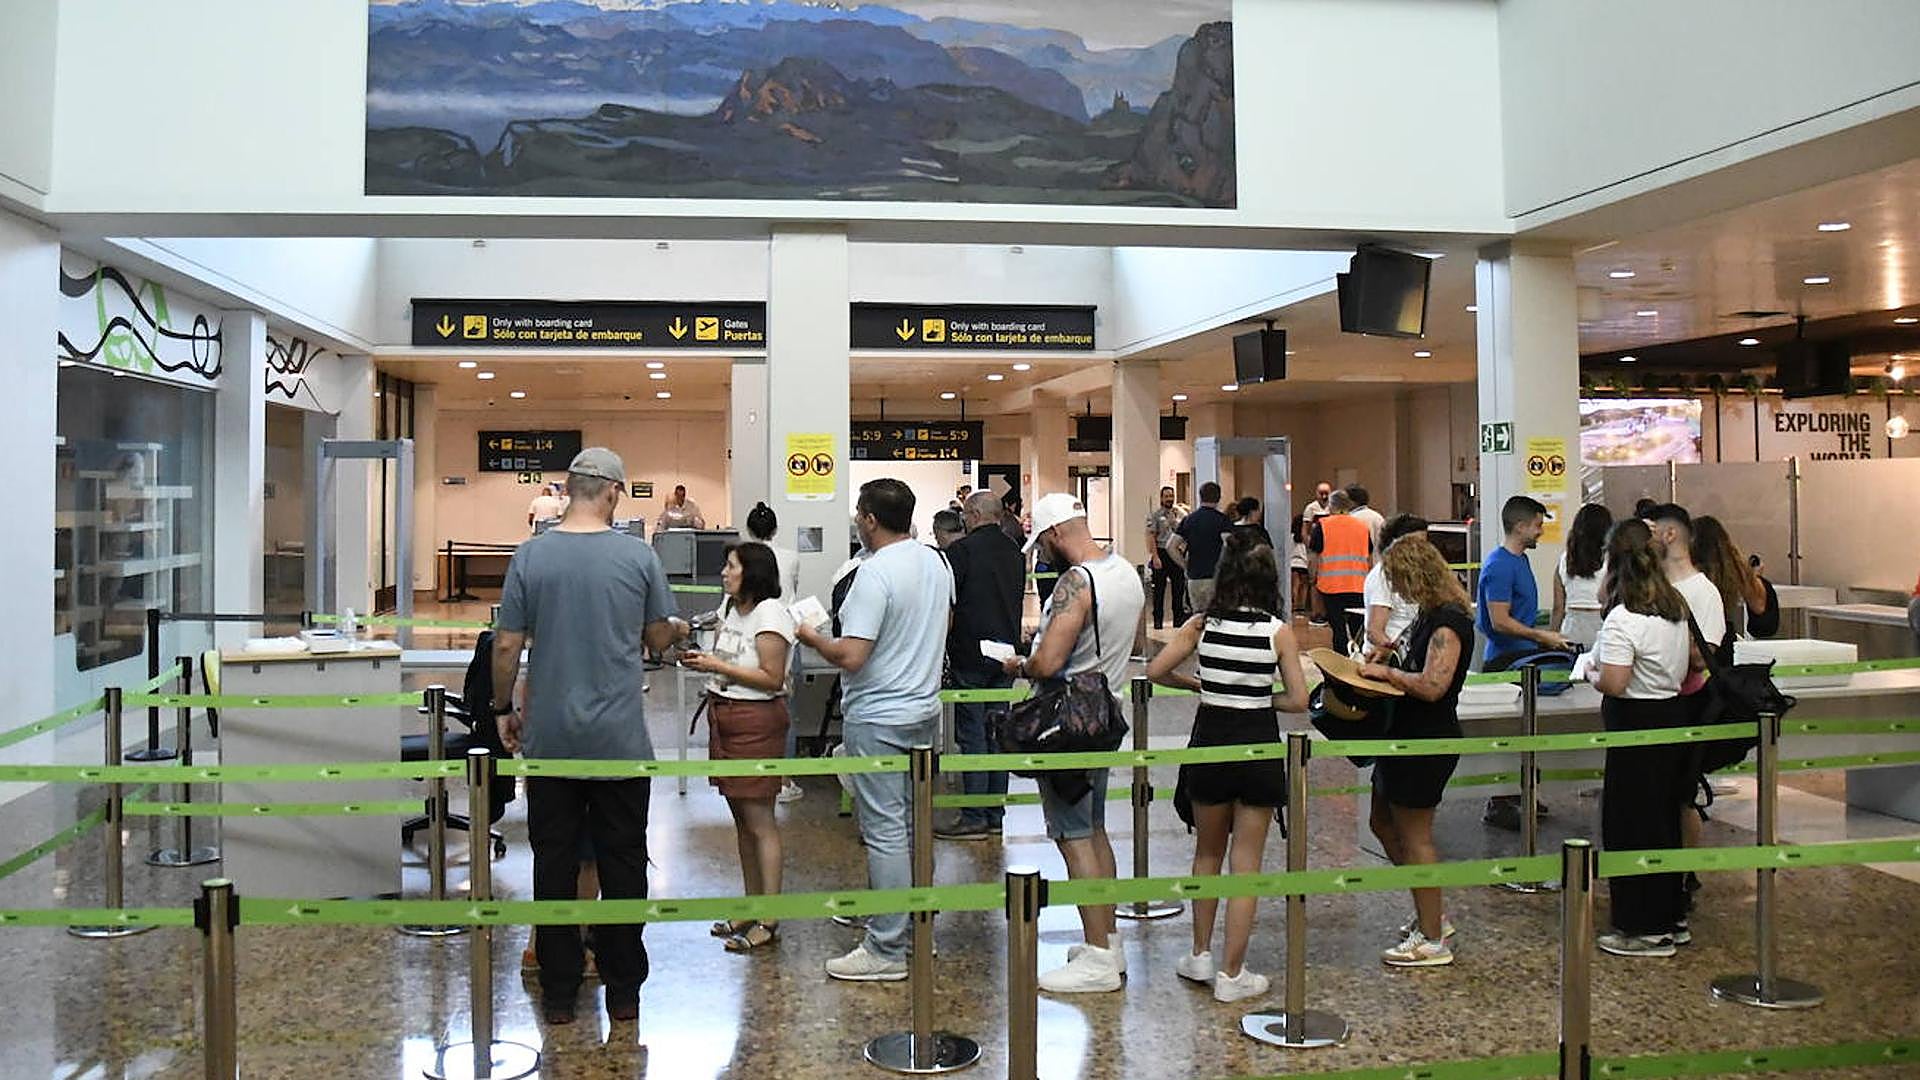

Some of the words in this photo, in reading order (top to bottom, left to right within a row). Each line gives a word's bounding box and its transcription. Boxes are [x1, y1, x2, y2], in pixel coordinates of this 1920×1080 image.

[493, 318, 512, 329] Only
[514, 318, 533, 327] with
[535, 318, 572, 329] boarding
[574, 318, 593, 328] card
[724, 320, 749, 329] Gates
[950, 321, 970, 332] Only
[971, 322, 989, 331] with
[991, 321, 1026, 333] boarding
[1027, 323, 1046, 331] card
[493, 328, 516, 339] Sólo
[518, 330, 538, 339] con
[540, 329, 573, 341] tarjeta
[575, 329, 589, 340] de
[591, 329, 643, 342] embarque
[724, 330, 763, 341] Puertas
[951, 331, 973, 343] Sólo
[975, 333, 993, 343] con
[996, 332, 1027, 345] tarjeta
[1029, 333, 1042, 343] de
[1043, 332, 1093, 345] embarque
[1775, 413, 1871, 432] EXPLORING
[1837, 433, 1871, 452] THE
